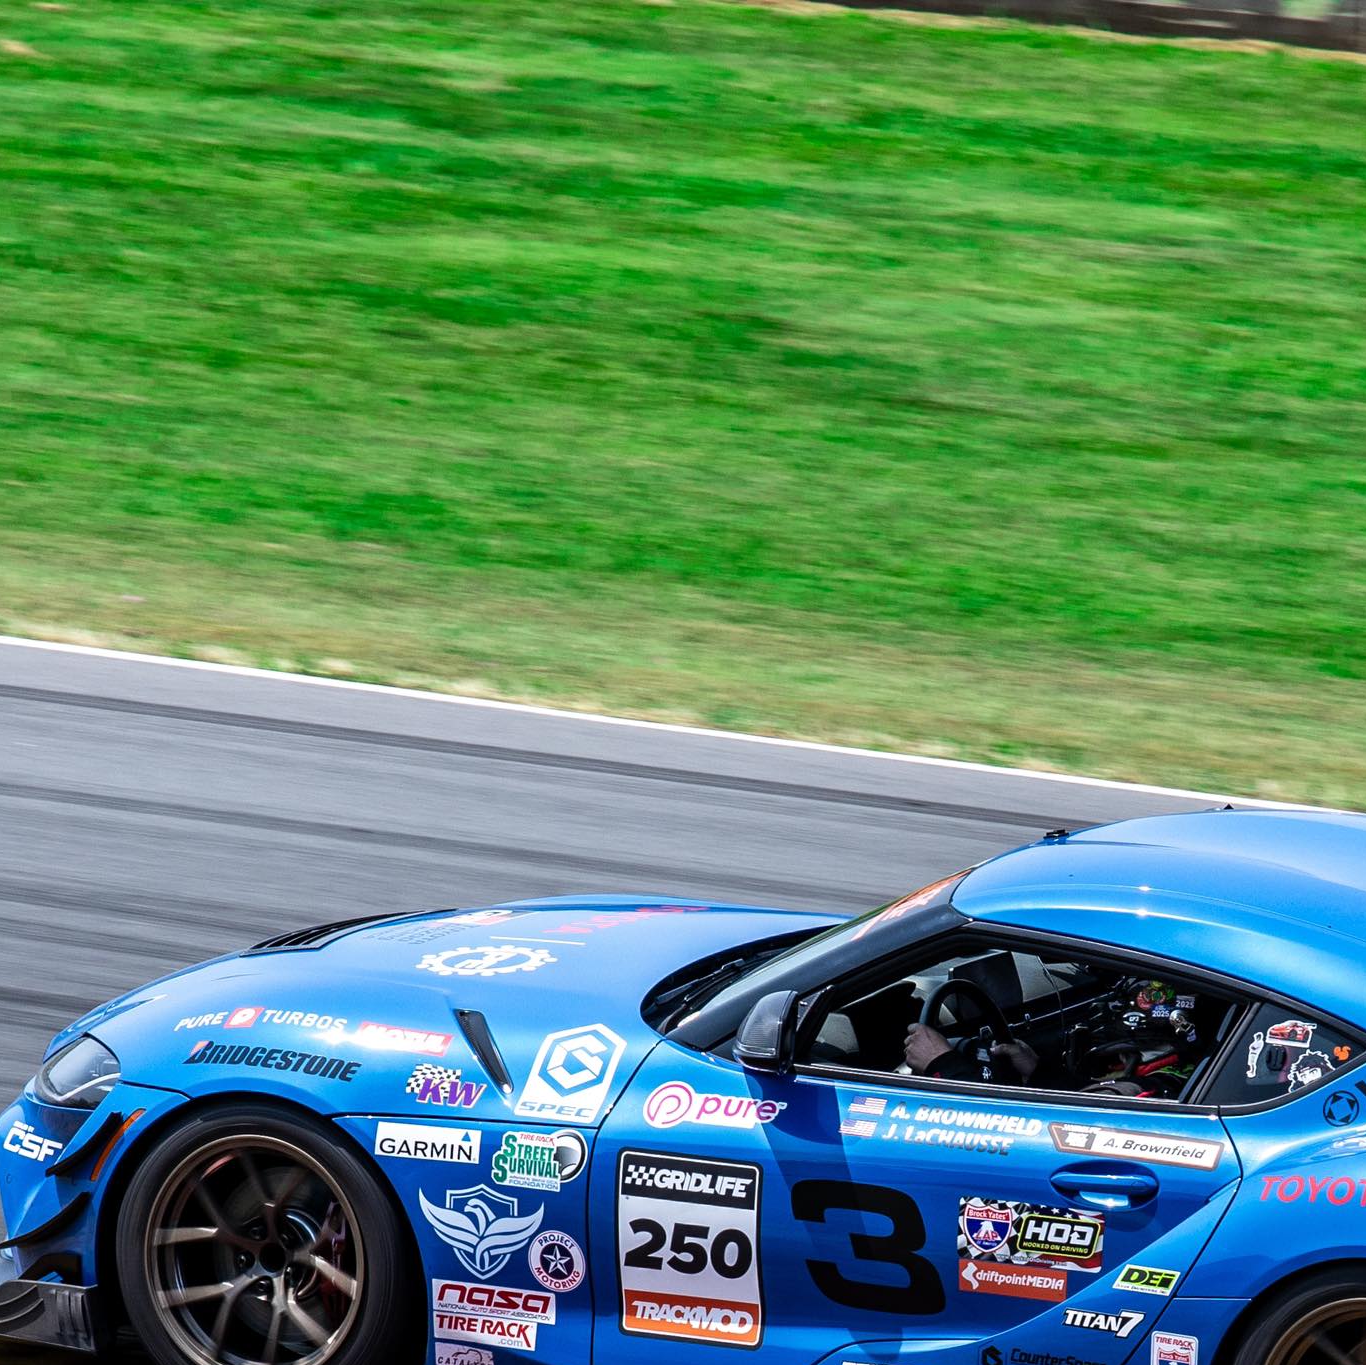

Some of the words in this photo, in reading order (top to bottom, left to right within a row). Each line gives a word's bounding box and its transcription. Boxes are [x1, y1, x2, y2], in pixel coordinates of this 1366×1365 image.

[174, 1011, 228, 1031] PURE
[262, 1010, 347, 1031] TURBOS
[182, 1040, 362, 1082] BRIDGESTONE
[416, 1077, 488, 1107] KW
[520, 1101, 593, 1118] SPEC
[696, 1096, 777, 1120] pure
[890, 1101, 911, 1120] A.
[914, 1104, 1044, 1137] BROWNFIELD
[3, 1127, 63, 1162] CSF
[379, 1138, 473, 1161] GARMIN
[503, 1134, 555, 1162] STREET
[882, 1123, 899, 1140] J.
[904, 1125, 1015, 1156] LaCHAUSSE
[1103, 1138, 1118, 1149] A.
[1122, 1140, 1206, 1159] Brownfield
[493, 1153, 559, 1182] SURVIVAL
[654, 1169, 754, 1198] GRIDLIFE
[968, 1208, 987, 1218] Brock
[538, 1234, 575, 1250] PROJECT
[1025, 1219, 1094, 1246] HOD
[624, 1218, 753, 1279] 250
[791, 1179, 947, 1316] 3
[1023, 1241, 1049, 1250] HOOKED
[1061, 1245, 1088, 1254] DRIVING
[535, 1266, 581, 1289] MOTORING
[976, 1269, 1065, 1291] driftpointMEDIA
[437, 1283, 551, 1314] nasa
[438, 1302, 469, 1312] NATIONAL
[470, 1305, 488, 1314] AUTO
[488, 1308, 511, 1316] SPORT
[511, 1311, 551, 1321] ASSOCIATION
[632, 1300, 754, 1334] TRACKMOD
[436, 1314, 478, 1333] TIRE
[480, 1319, 532, 1348] RACK
[1155, 1336, 1173, 1345] TIRE
[1173, 1339, 1194, 1351] RACK
